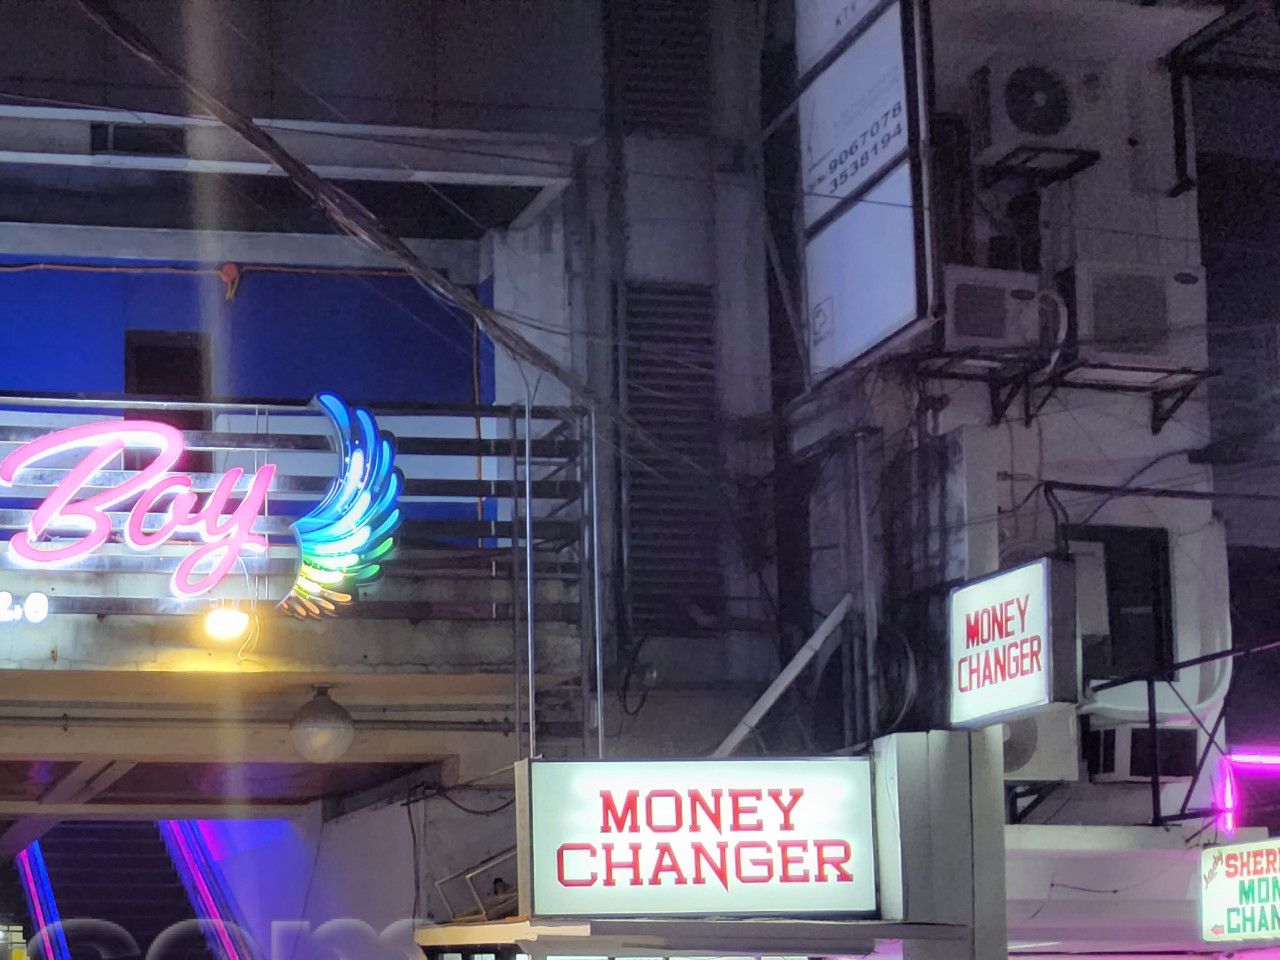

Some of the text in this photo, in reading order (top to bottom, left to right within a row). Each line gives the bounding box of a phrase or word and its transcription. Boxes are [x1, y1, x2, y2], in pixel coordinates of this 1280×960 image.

[830, 122, 903, 194] 3538194
[965, 595, 1031, 649] MONEY
[957, 634, 1043, 693] CHANGER
[600, 788, 804, 836] MONEY
[556, 839, 854, 892] CHANGER
[1225, 848, 1280, 879] SHER
